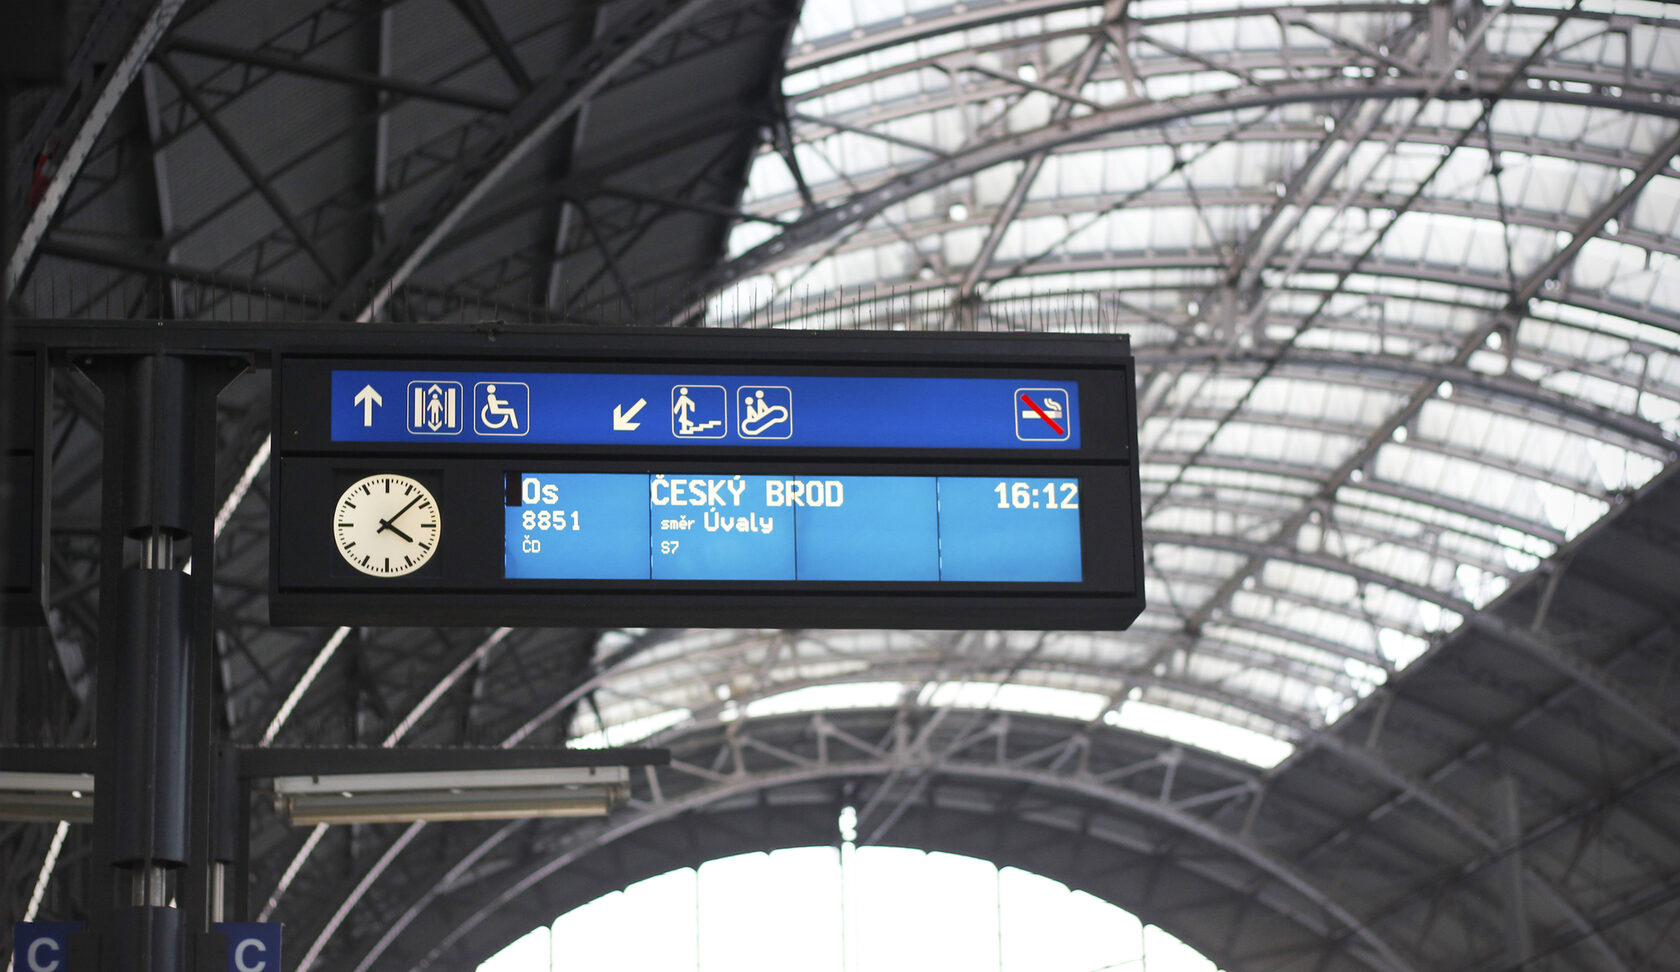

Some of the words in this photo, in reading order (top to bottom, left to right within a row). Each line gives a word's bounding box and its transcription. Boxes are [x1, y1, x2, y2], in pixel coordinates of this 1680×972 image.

[651, 474, 746, 506] ČESKÝ
[766, 480, 844, 507] BROD
[994, 482, 1079, 509] 16:12
[522, 510, 581, 531] 8851
[660, 515, 695, 531] směr
[704, 507, 774, 534] Úvaly
[522, 534, 541, 554] ČD
[661, 541, 680, 555] S7
[27, 937, 60, 972] C
[234, 938, 267, 972] C
